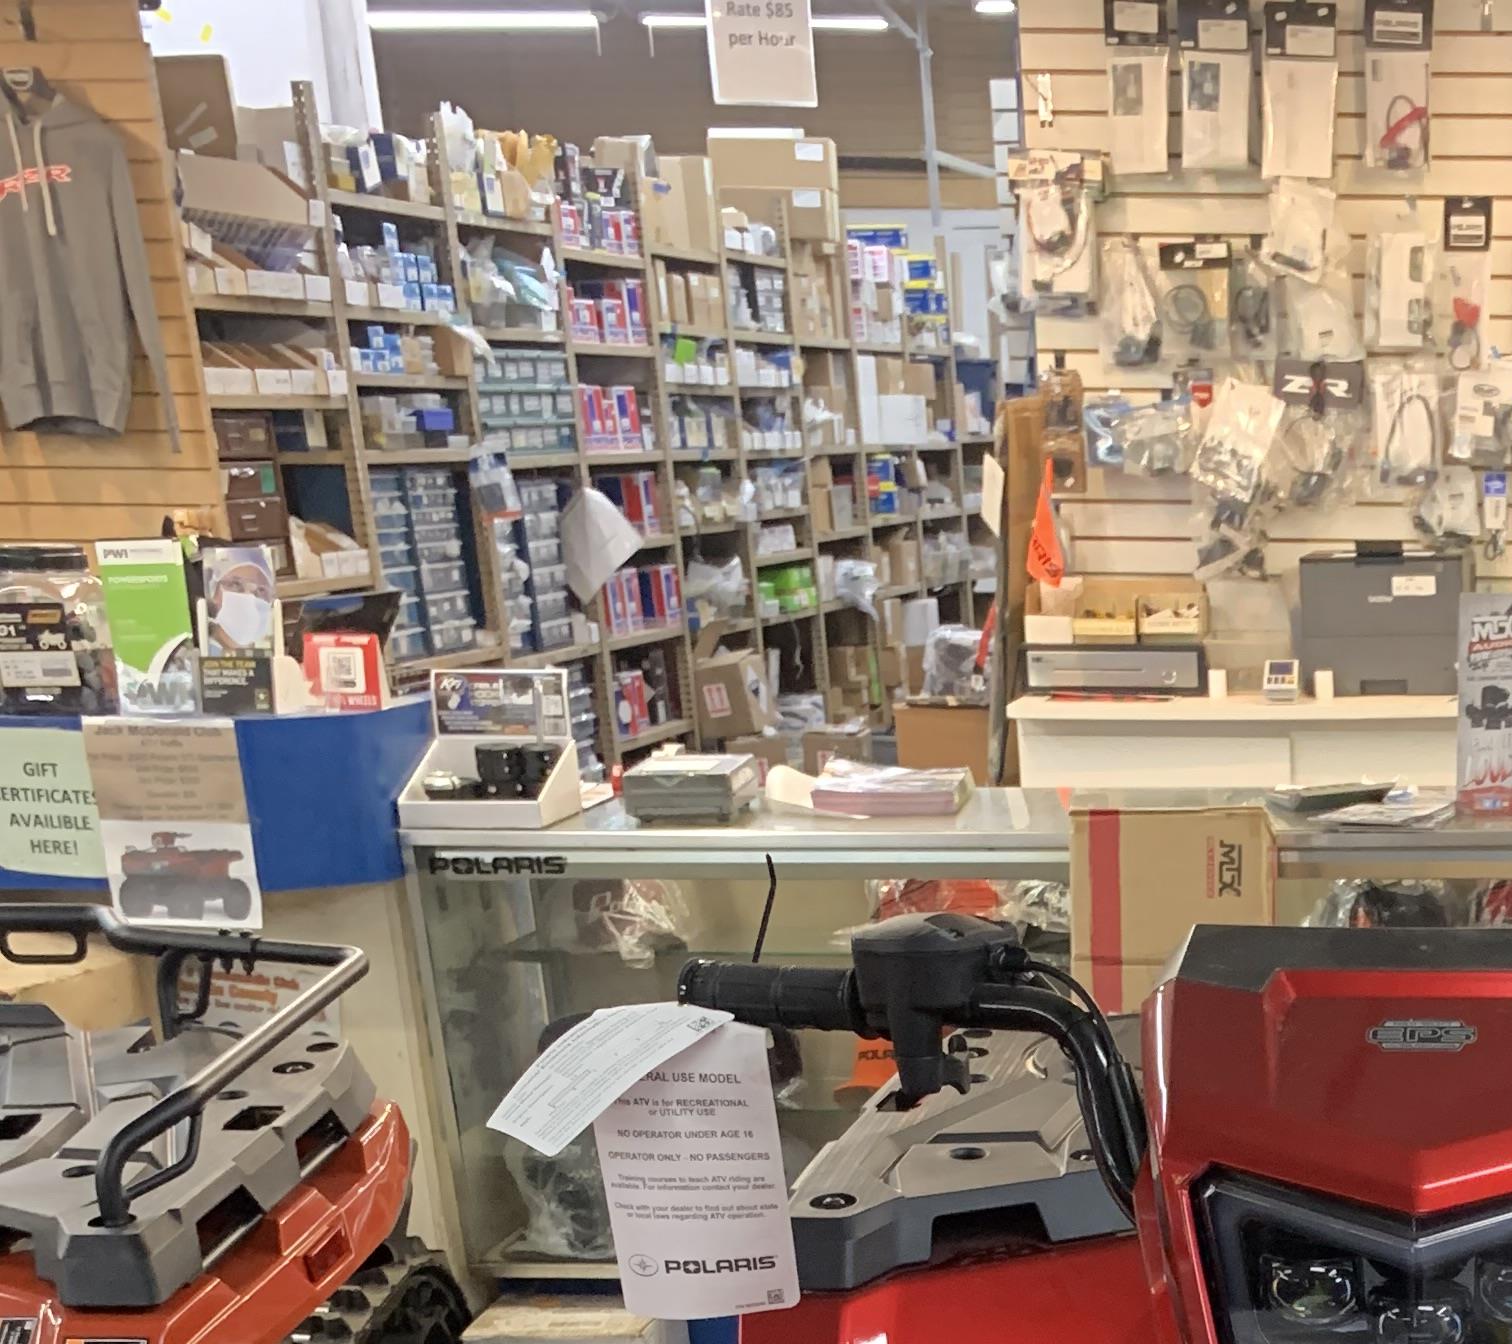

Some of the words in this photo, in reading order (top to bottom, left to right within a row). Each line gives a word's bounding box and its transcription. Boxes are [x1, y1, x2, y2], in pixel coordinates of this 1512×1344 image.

[726, 1, 760, 17] Rate
[766, 2, 793, 19] $85
[729, 33, 753, 48] per
[758, 31, 796, 46] Hour
[23, 762, 58, 778] GIFT
[0, 787, 97, 805] ERTIFICATE
[9, 813, 94, 831] AVAILIBLE
[30, 840, 79, 857] HERE!
[428, 856, 568, 875] POLARIS
[672, 1073, 695, 1083] USE
[699, 1073, 741, 1084] MODEL
[633, 1098, 649, 1106] ATV
[661, 1098, 674, 1107] for
[676, 1099, 749, 1108] RECREATIONAL
[659, 1108, 694, 1117] UTILITY
[697, 1109, 716, 1117] USE
[617, 1129, 631, 1138] NO
[632, 1130, 682, 1139] OPERATOR
[684, 1130, 718, 1139] UNDER
[720, 1130, 740, 1139] AGE
[743, 1130, 754, 1139] 16
[608, 1151, 655, 1161] OPERATOR
[657, 1152, 681, 1162] ONLY
[689, 1153, 704, 1161] NO
[706, 1152, 770, 1161] PASSENGERS
[711, 1174, 727, 1182] ATV
[665, 1256, 776, 1274] POLARIS
